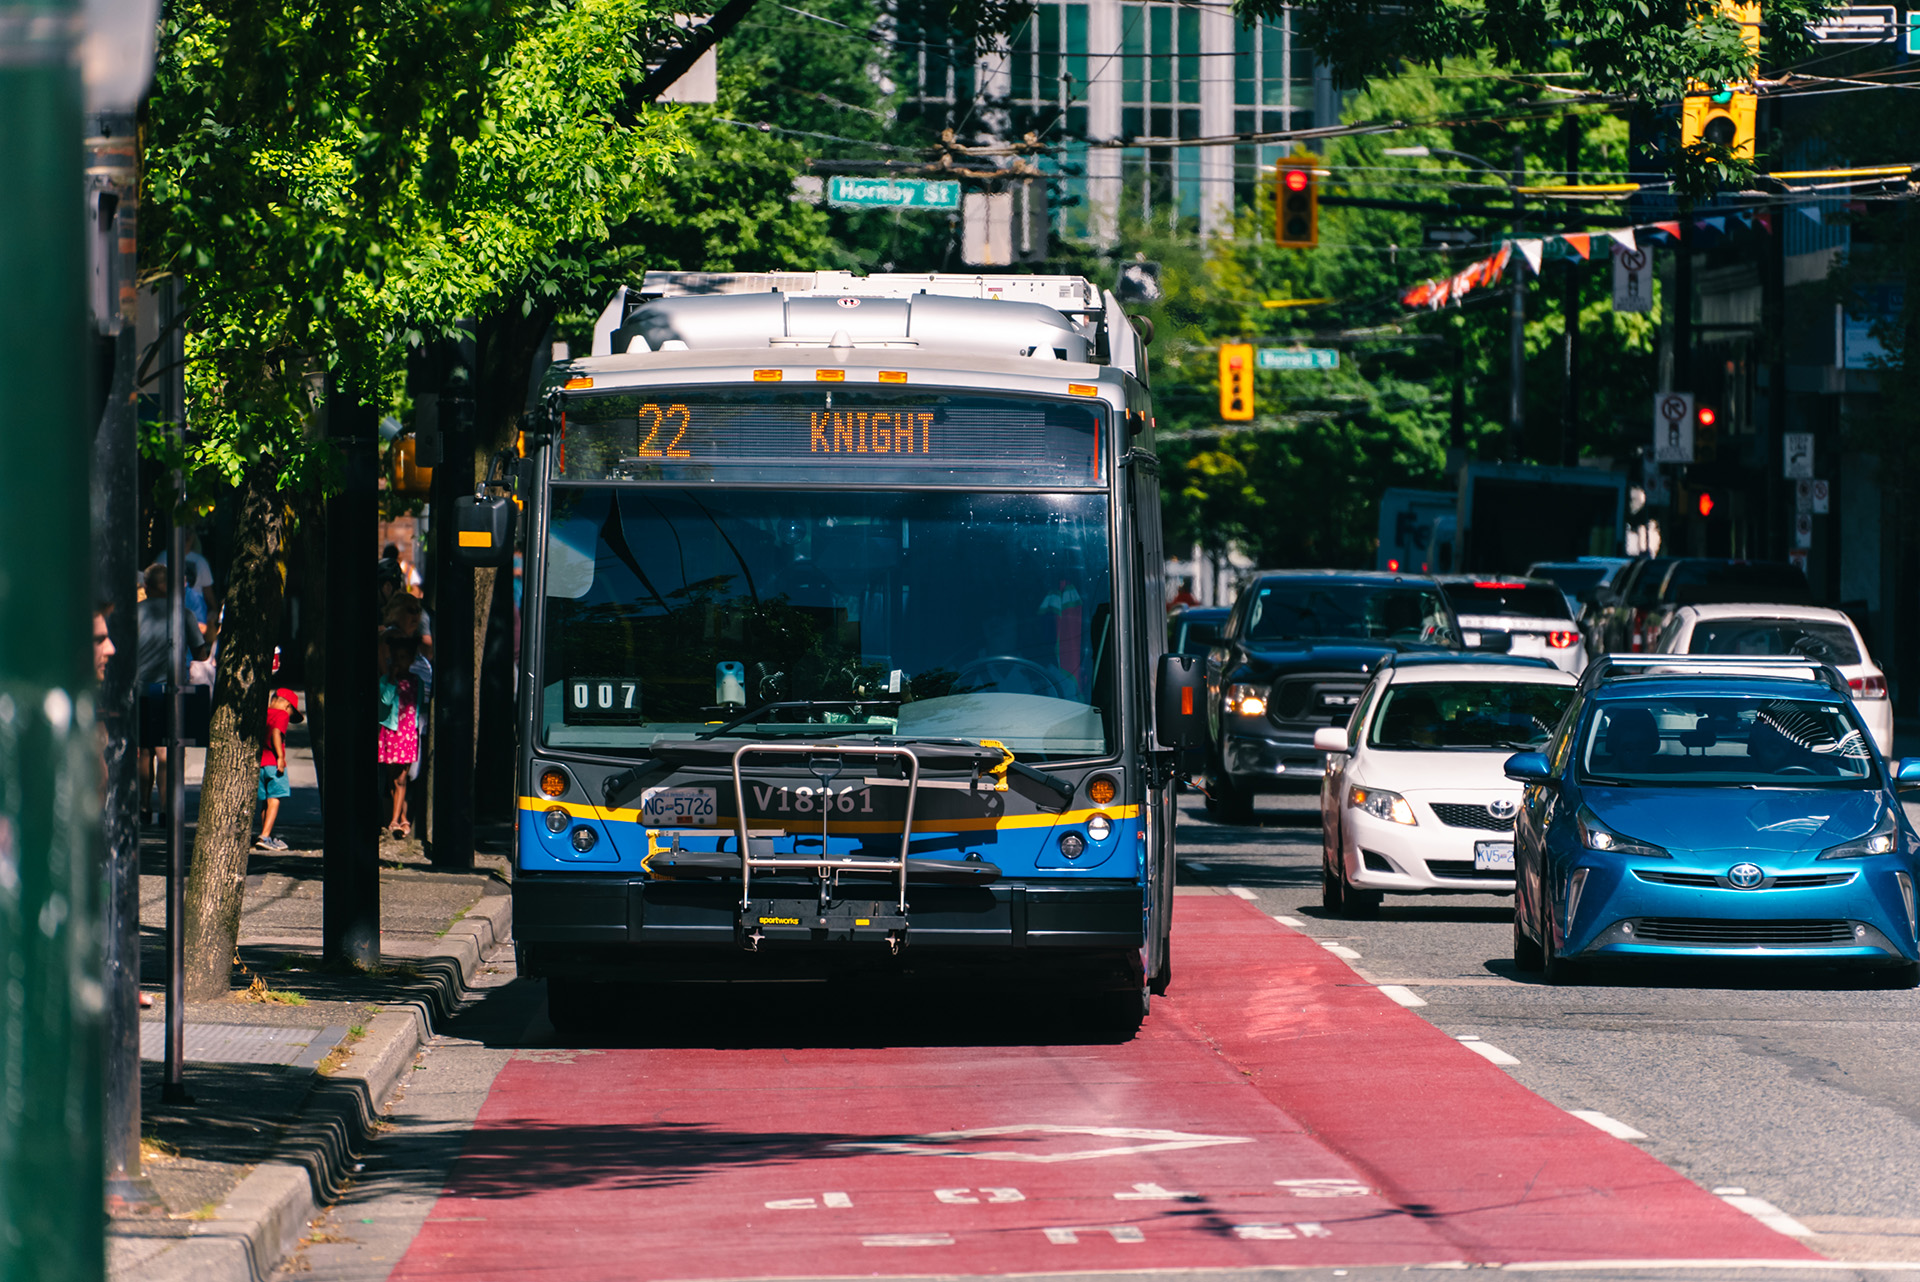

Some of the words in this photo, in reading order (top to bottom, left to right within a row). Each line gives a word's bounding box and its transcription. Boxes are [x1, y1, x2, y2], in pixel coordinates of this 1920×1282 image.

[839, 180, 915, 204] Hornby
[924, 184, 949, 203] St
[639, 404, 690, 456] 22
[811, 412, 934, 453] KNIGHT
[574, 683, 636, 709] 007
[752, 785, 874, 813] V18361
[758, 916, 799, 925] sportworks
